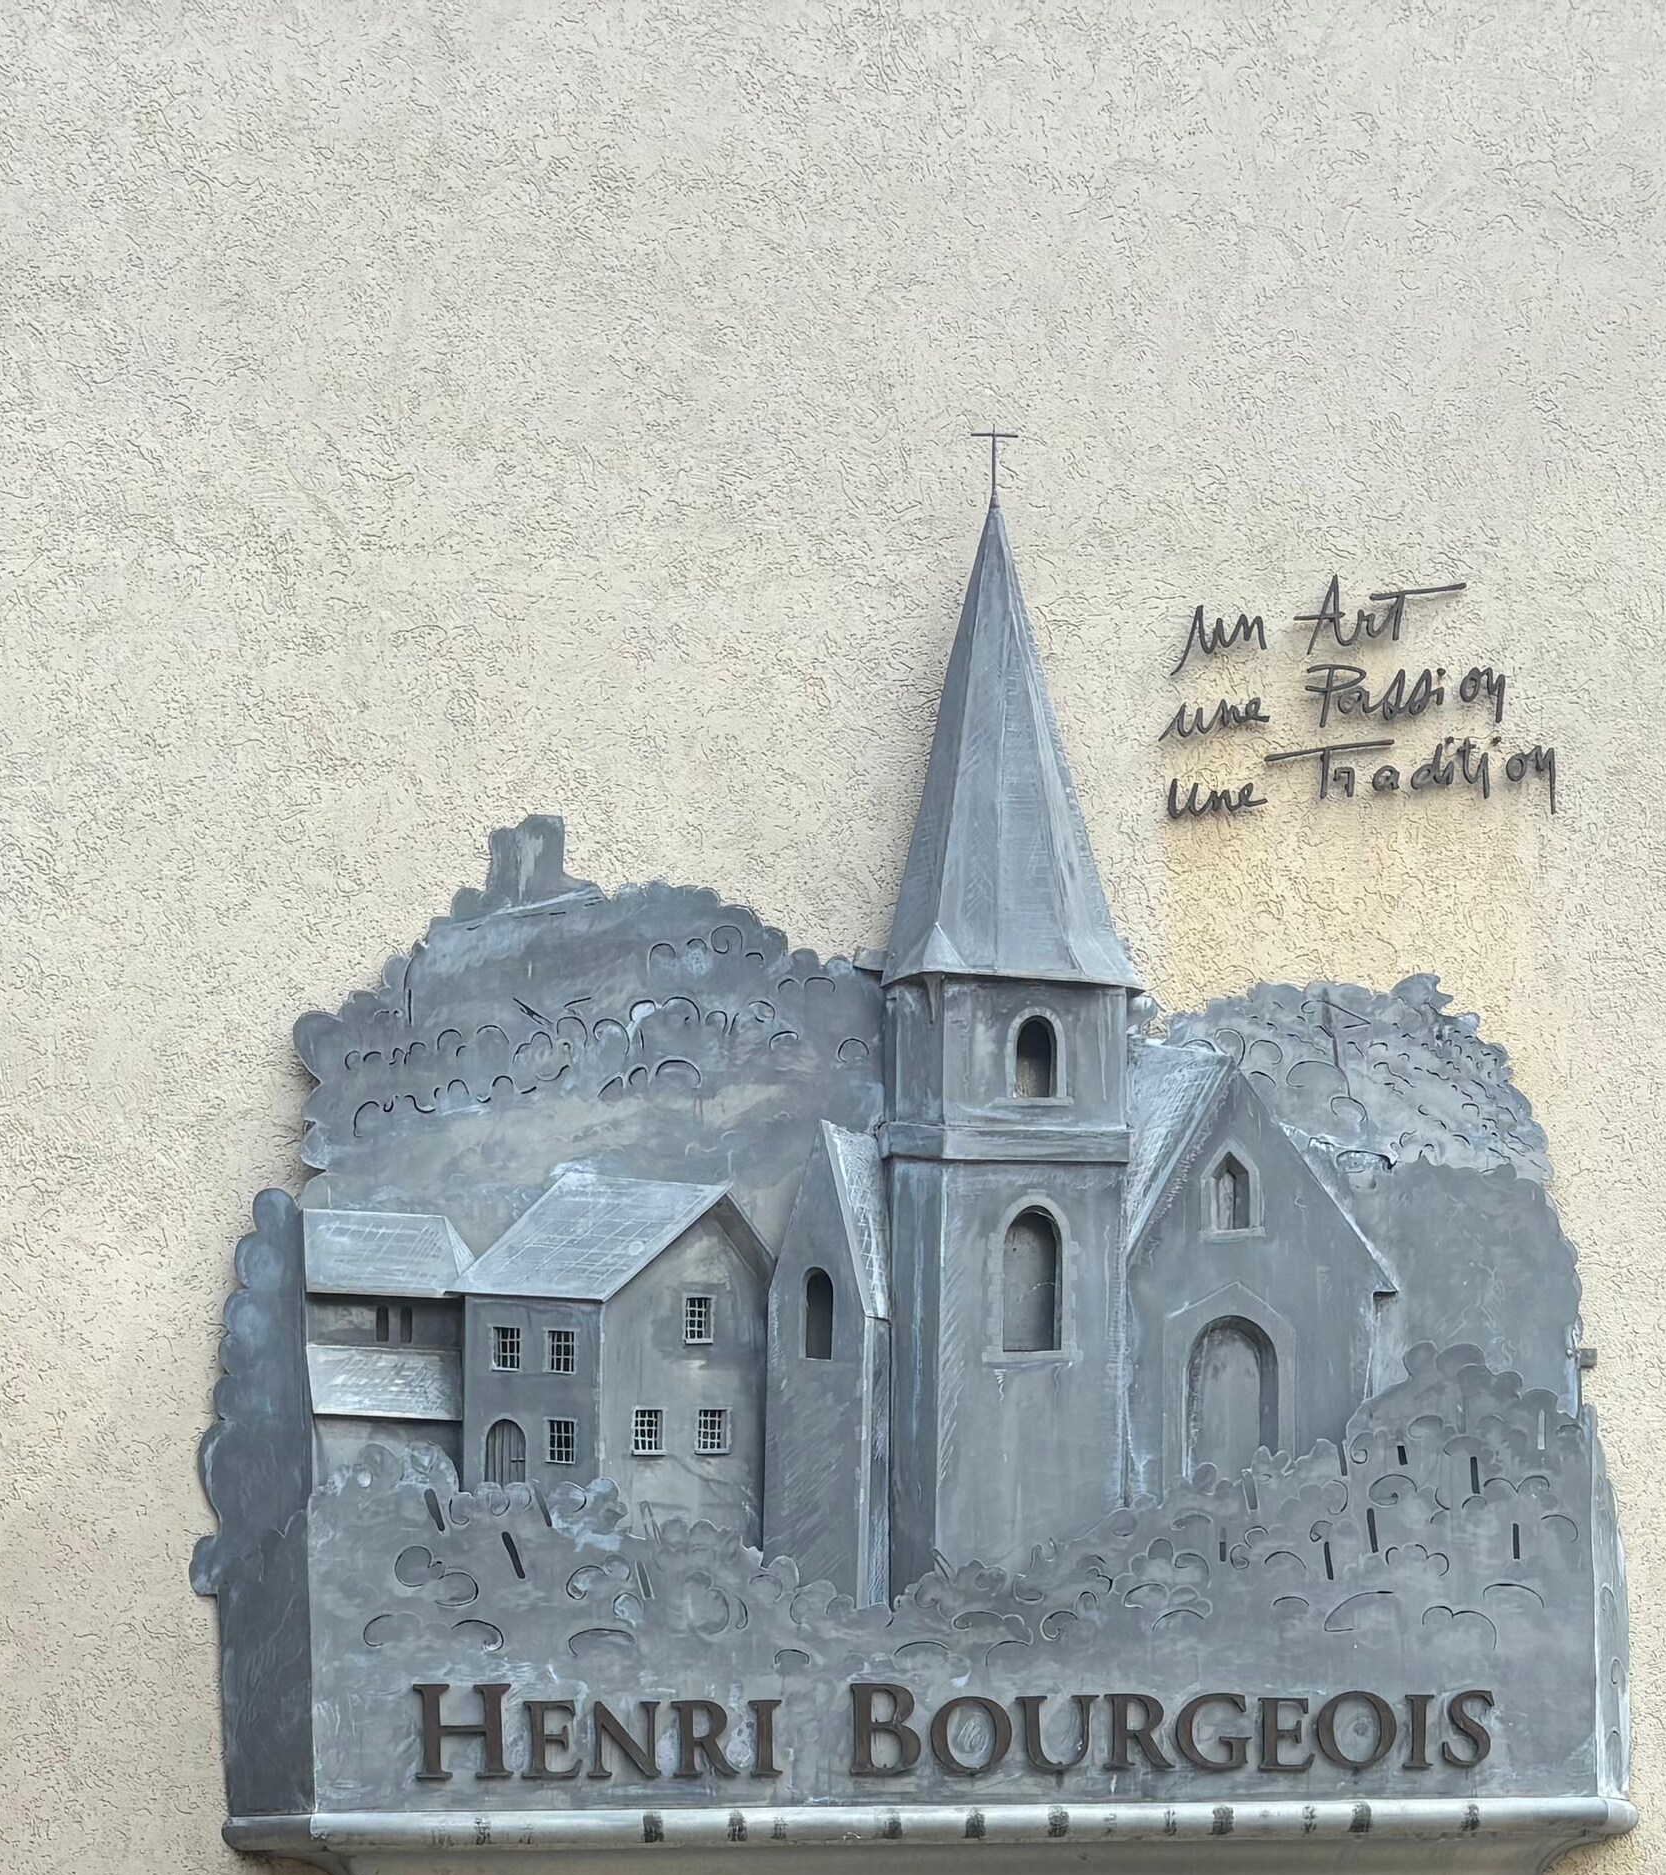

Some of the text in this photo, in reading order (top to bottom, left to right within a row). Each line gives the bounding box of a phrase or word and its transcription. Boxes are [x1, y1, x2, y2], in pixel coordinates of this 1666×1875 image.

[1293, 573, 1468, 656] Art
[1304, 663, 1507, 729] Passion
[1264, 737, 1557, 816] Tradition
[413, 1681, 1496, 1781] HENRI BOURGEOIS
